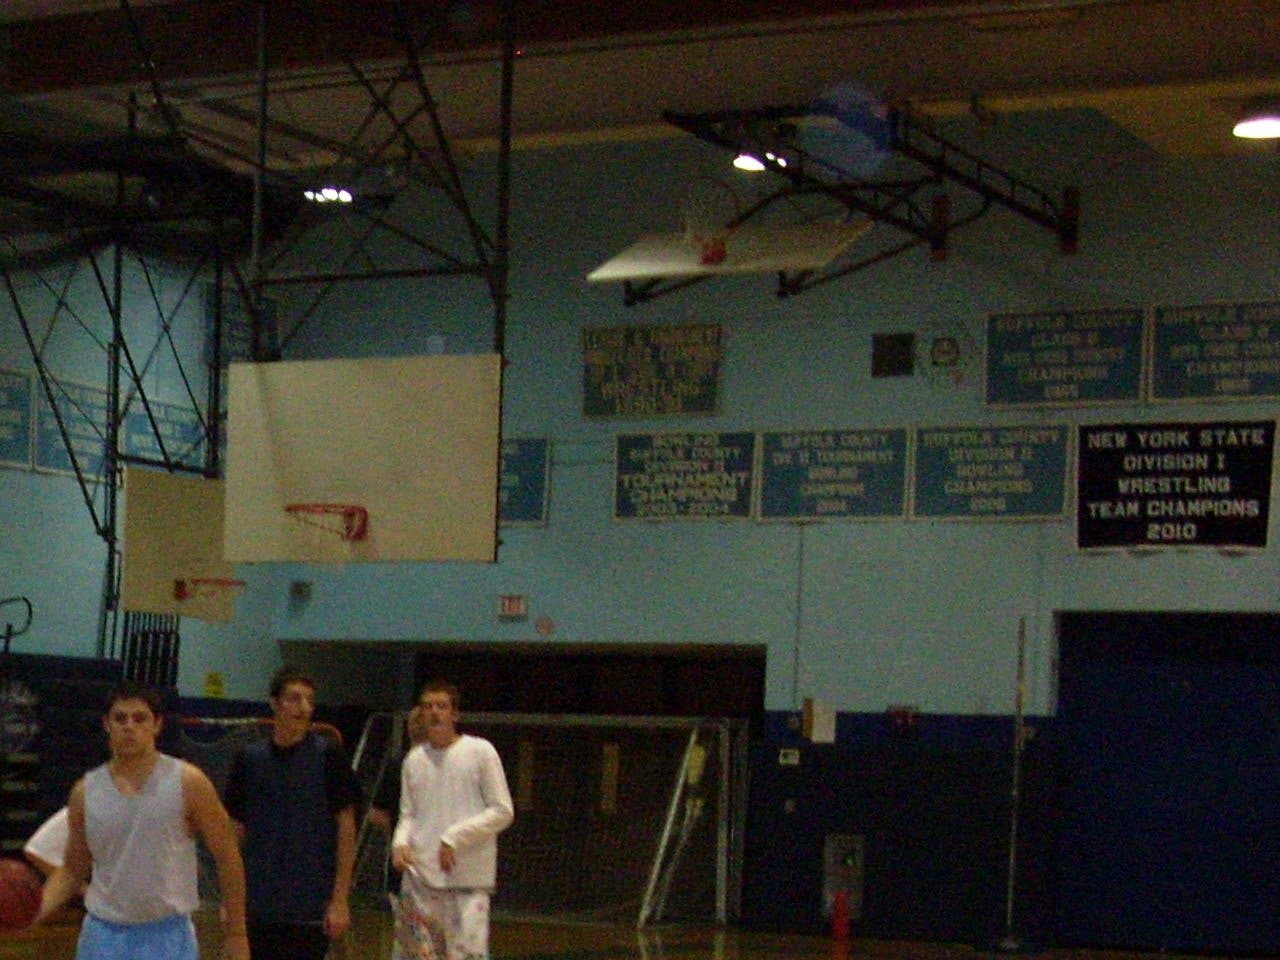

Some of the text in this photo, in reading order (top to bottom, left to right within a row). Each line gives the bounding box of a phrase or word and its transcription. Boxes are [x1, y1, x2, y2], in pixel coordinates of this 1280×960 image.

[1088, 428, 1266, 448] NEW YORK STATE
[1123, 453, 1226, 471] DIVISION I
[1118, 476, 1231, 494] WRESTLING
[1087, 499, 1260, 518] TEAM CHAMPIONS
[1147, 523, 1198, 540] 2010
